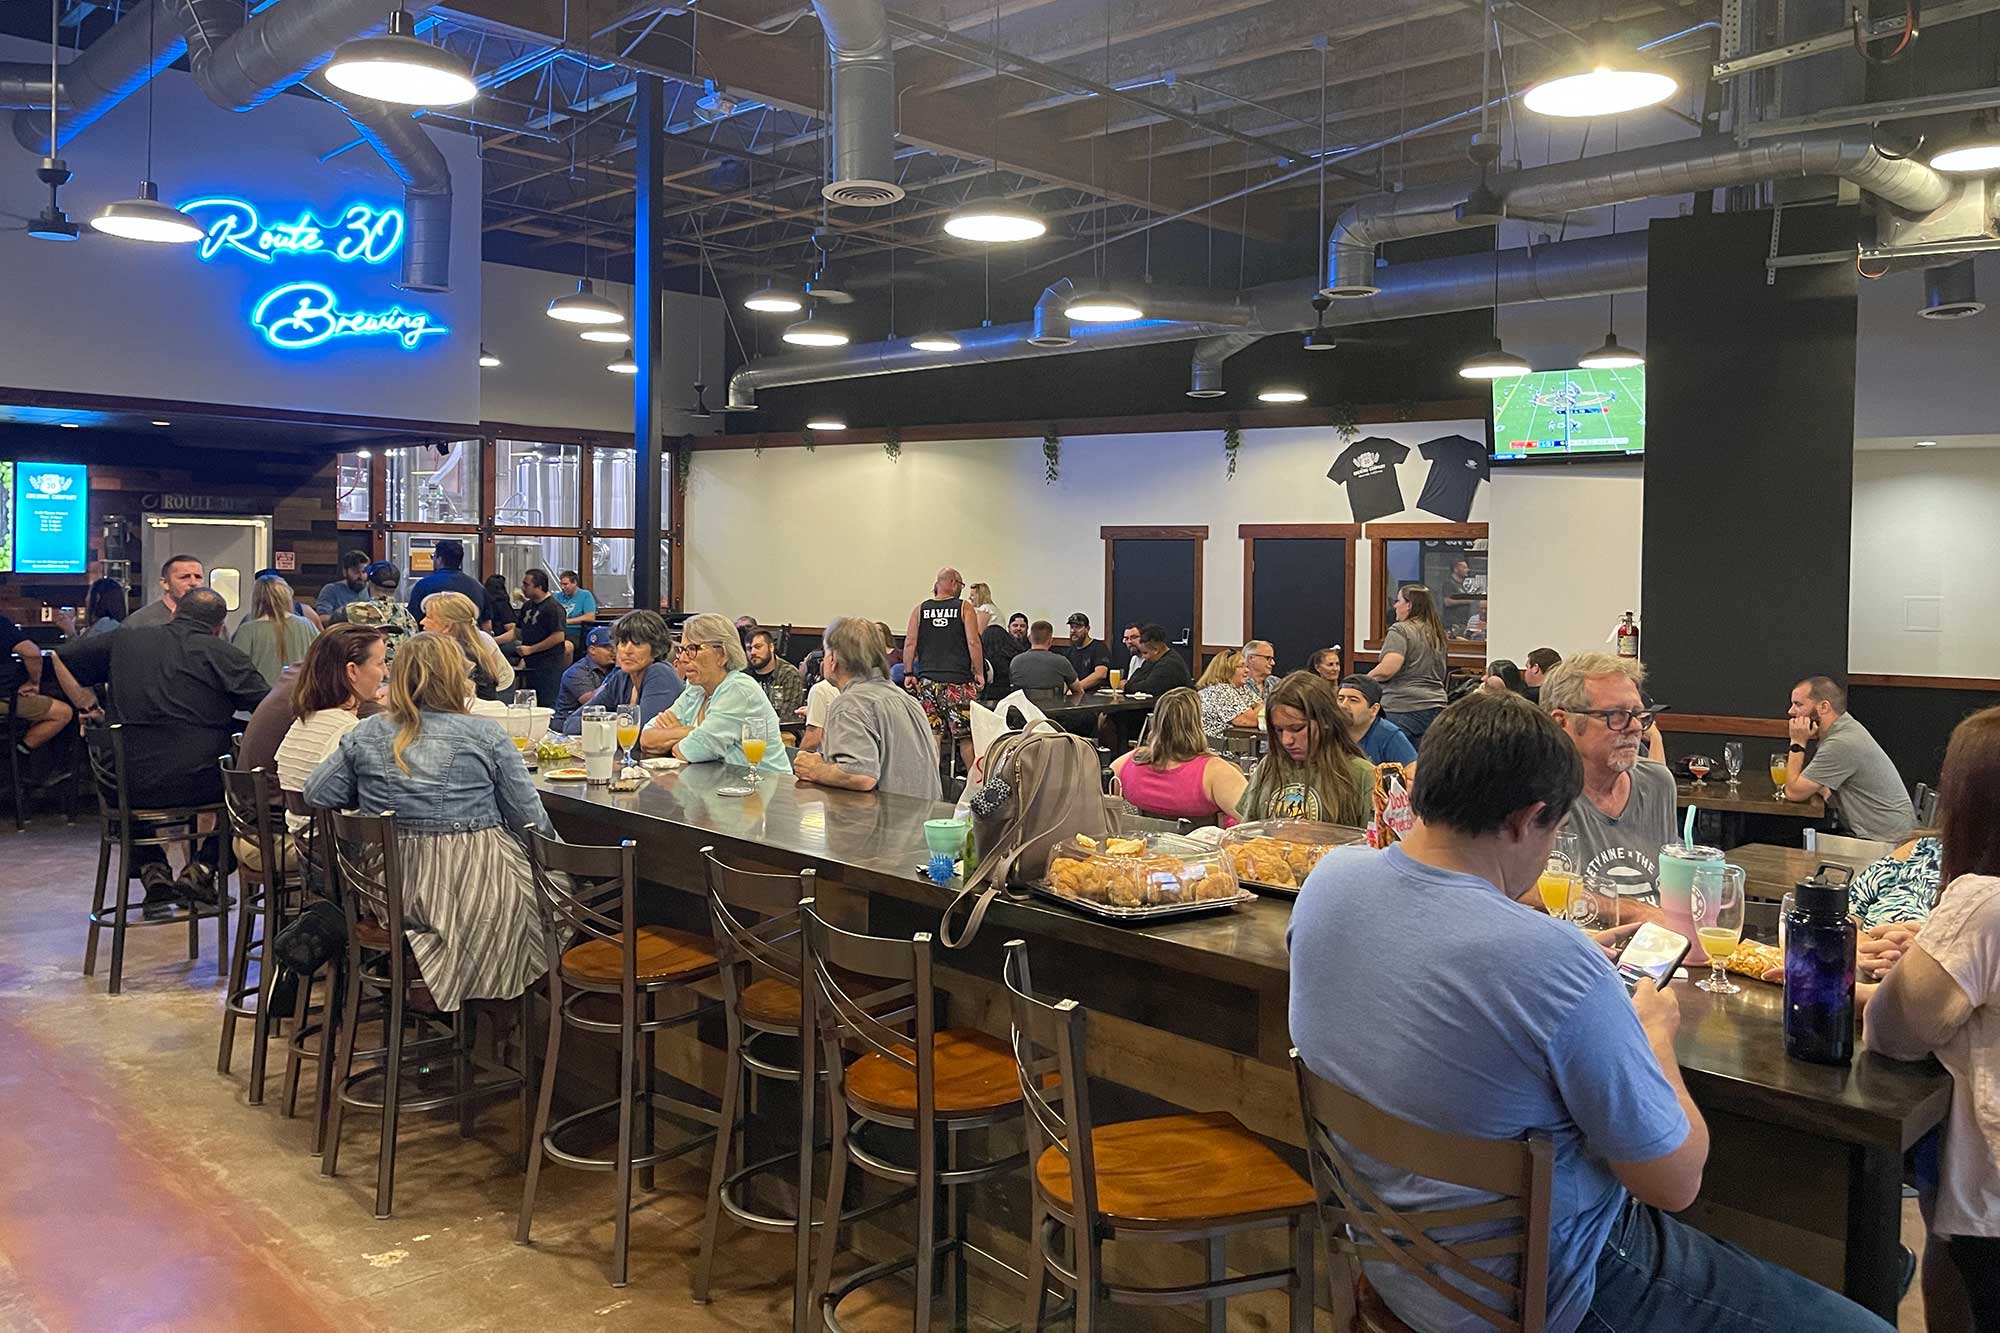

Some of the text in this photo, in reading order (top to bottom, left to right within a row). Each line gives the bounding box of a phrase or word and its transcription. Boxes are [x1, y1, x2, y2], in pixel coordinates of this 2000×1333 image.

[177, 198, 402, 262] Route 30
[254, 282, 447, 347] Brewing
[923, 608, 958, 619] HAWAII
[1635, 850, 1655, 874] THE
